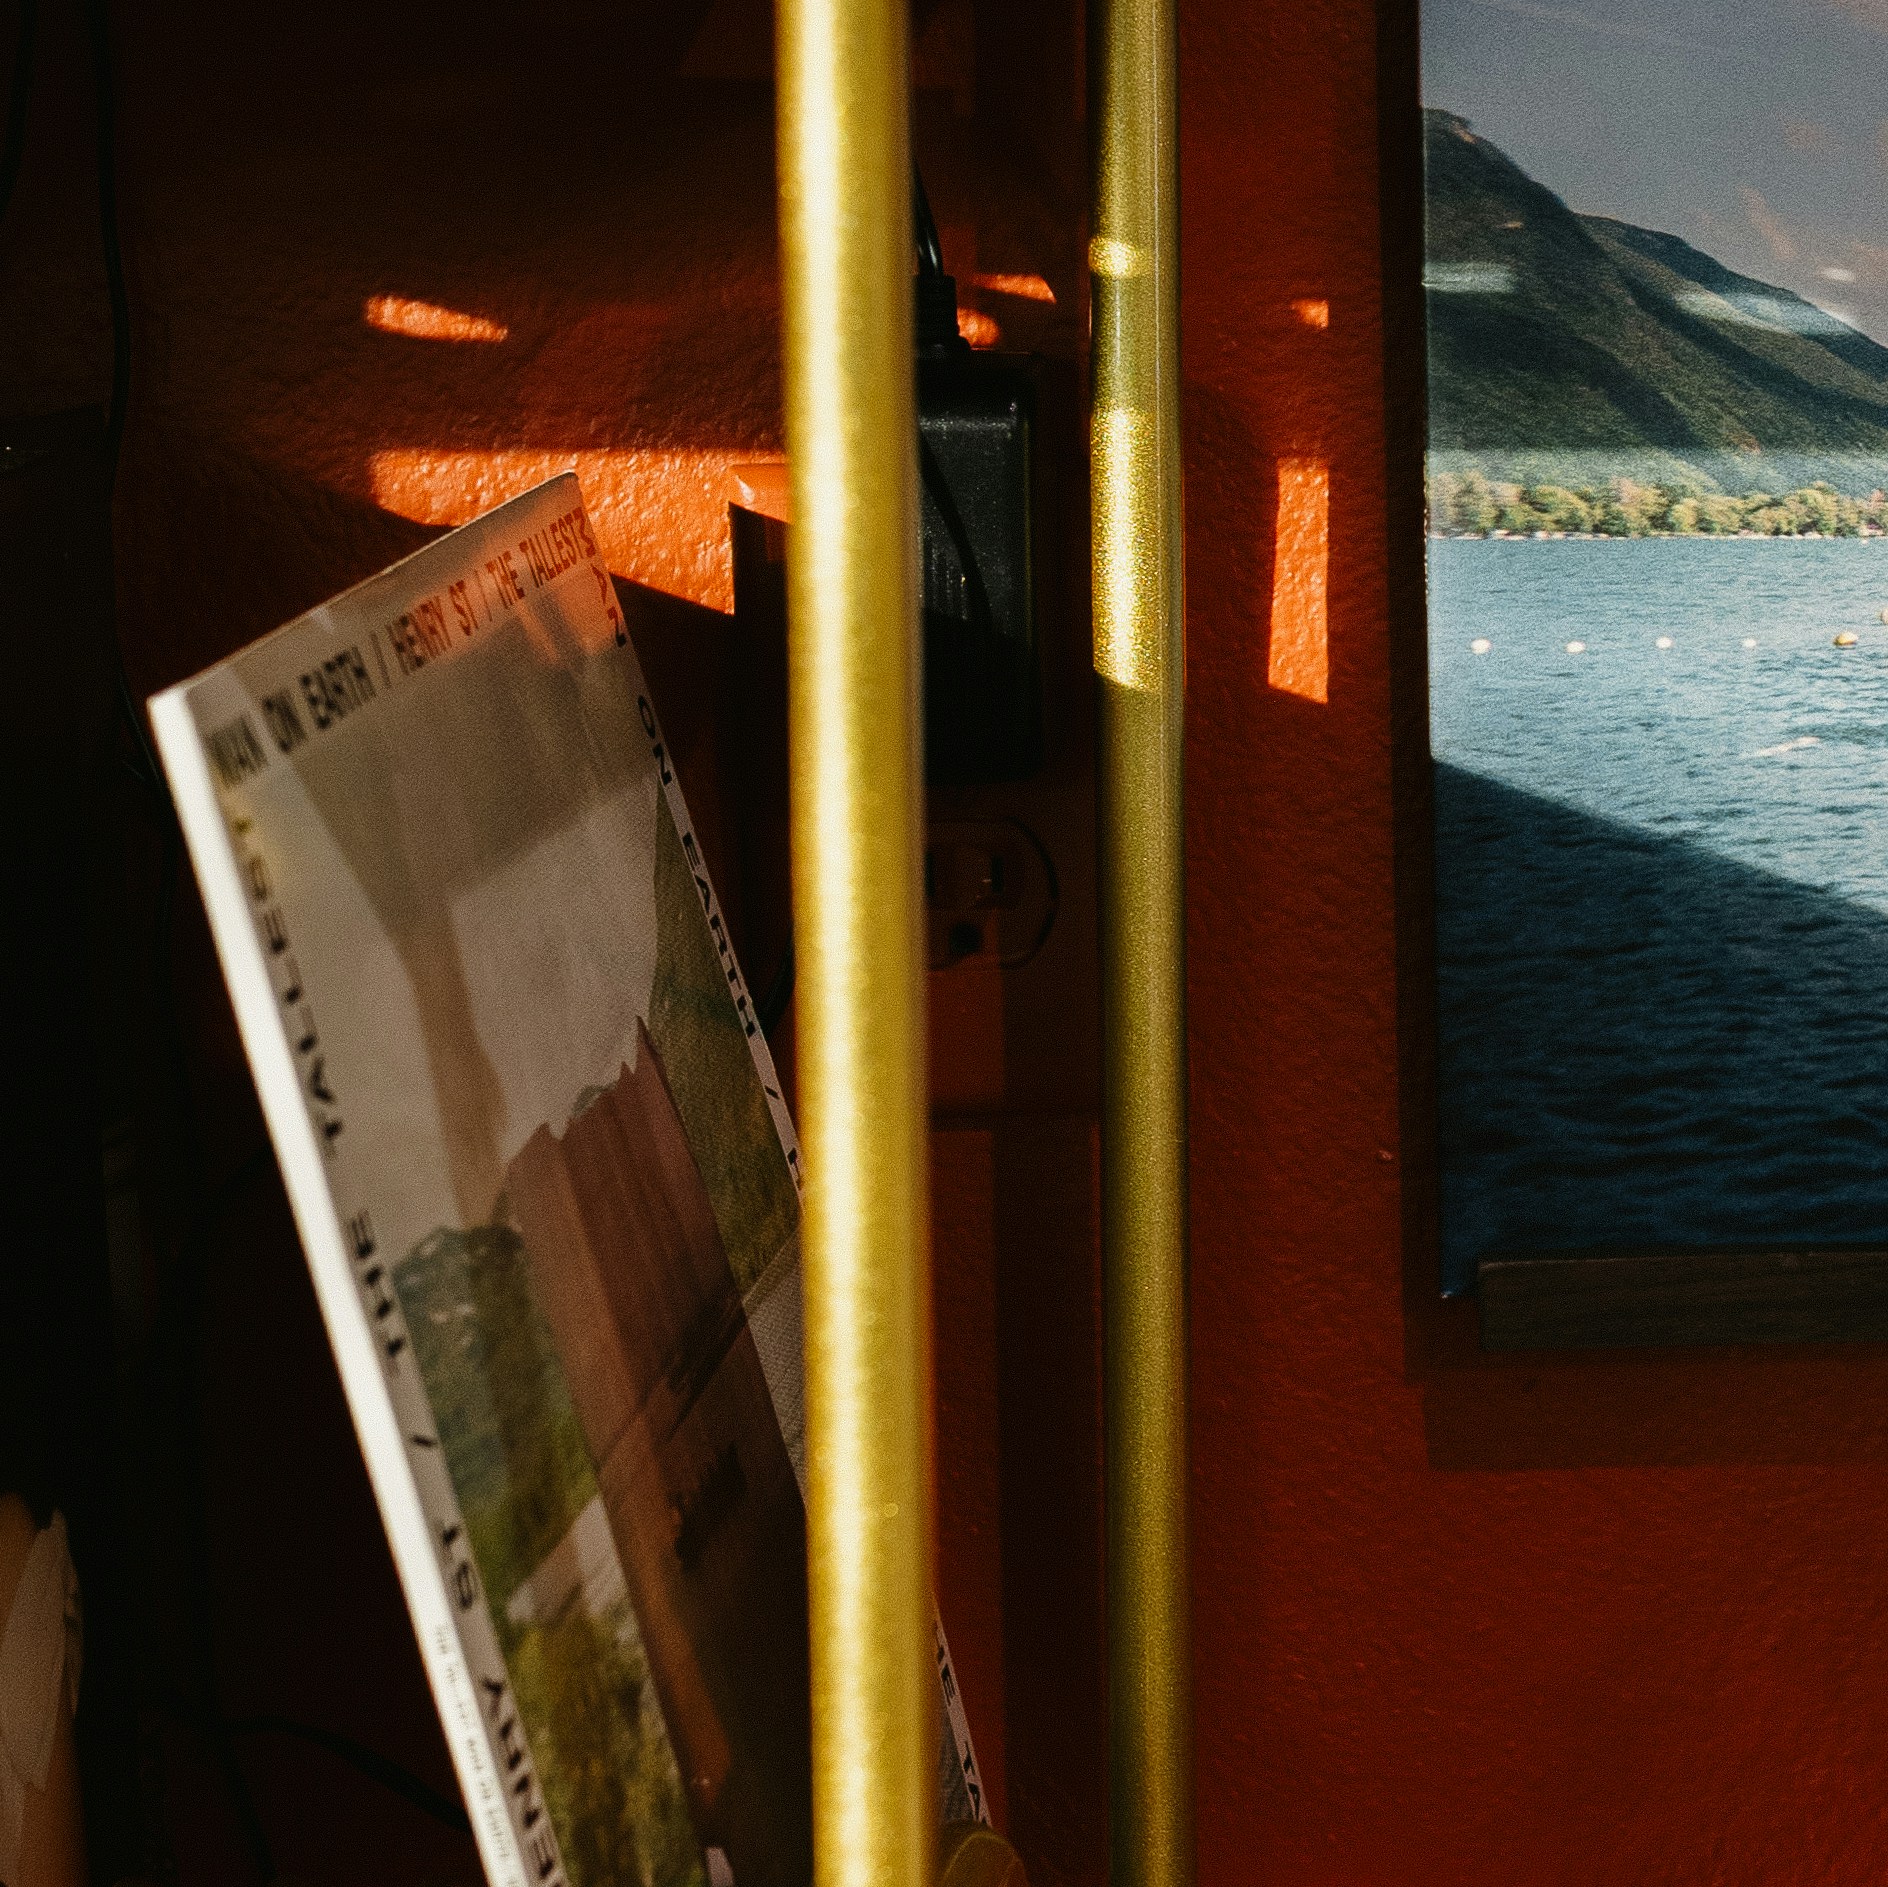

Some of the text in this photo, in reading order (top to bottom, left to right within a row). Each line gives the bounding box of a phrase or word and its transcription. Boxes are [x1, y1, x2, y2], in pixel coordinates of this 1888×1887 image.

[262, 685, 306, 754] ON
[300, 646, 377, 730] EARTH
[388, 595, 453, 677] HENRY
[448, 579, 479, 636] ST
[485, 550, 526, 610] THE
[519, 509, 585, 589] TALLEST
[231, 814, 343, 1160] TALLEST
[638, 695, 673, 785] ON
[682, 832, 756, 1038] EARTH
[346, 1209, 408, 1374] THE
[437, 1520, 476, 1612] ST
